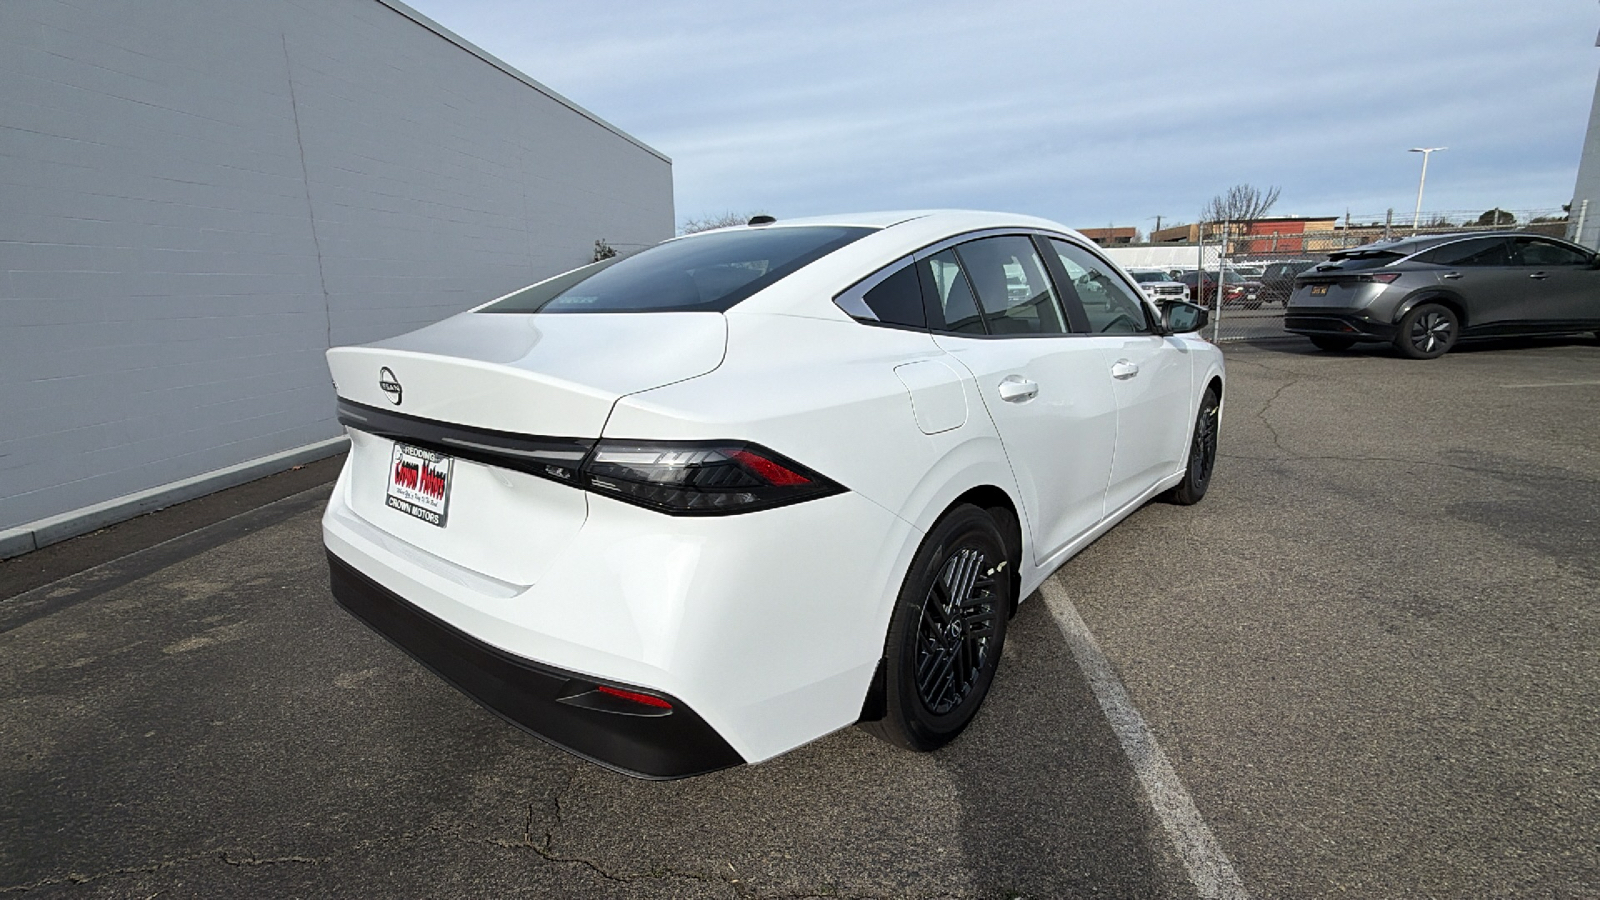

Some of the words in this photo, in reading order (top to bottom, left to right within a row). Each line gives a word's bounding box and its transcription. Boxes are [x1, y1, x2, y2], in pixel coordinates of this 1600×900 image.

[405, 446, 435, 461] REDDING
[389, 497, 411, 515] CROWN
[411, 506, 439, 524] MOTORS
